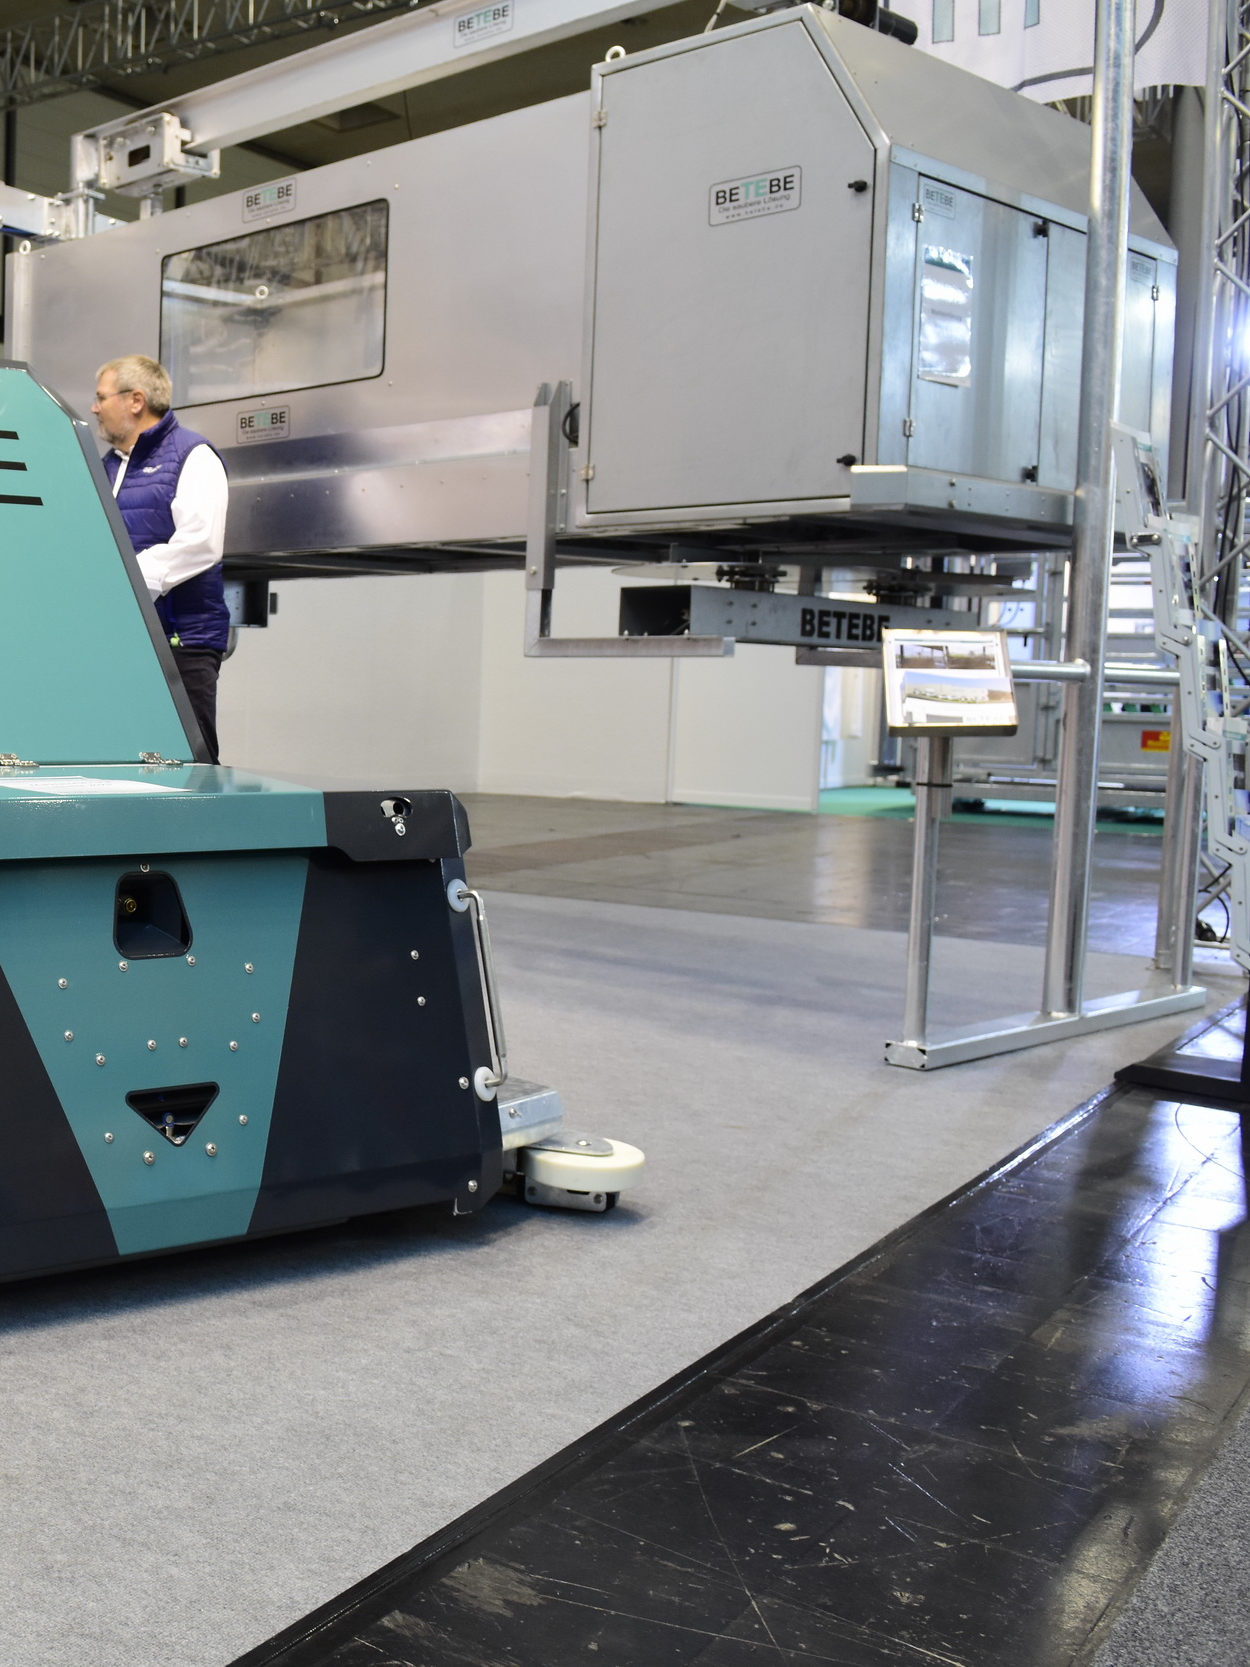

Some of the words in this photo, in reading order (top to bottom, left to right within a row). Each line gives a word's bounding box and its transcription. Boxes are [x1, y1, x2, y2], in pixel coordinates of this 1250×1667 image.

[457, 4, 509, 33] BETEBE
[246, 183, 293, 208] BETEBE
[715, 174, 795, 206] BETEBE
[240, 411, 286, 429] BETEBE
